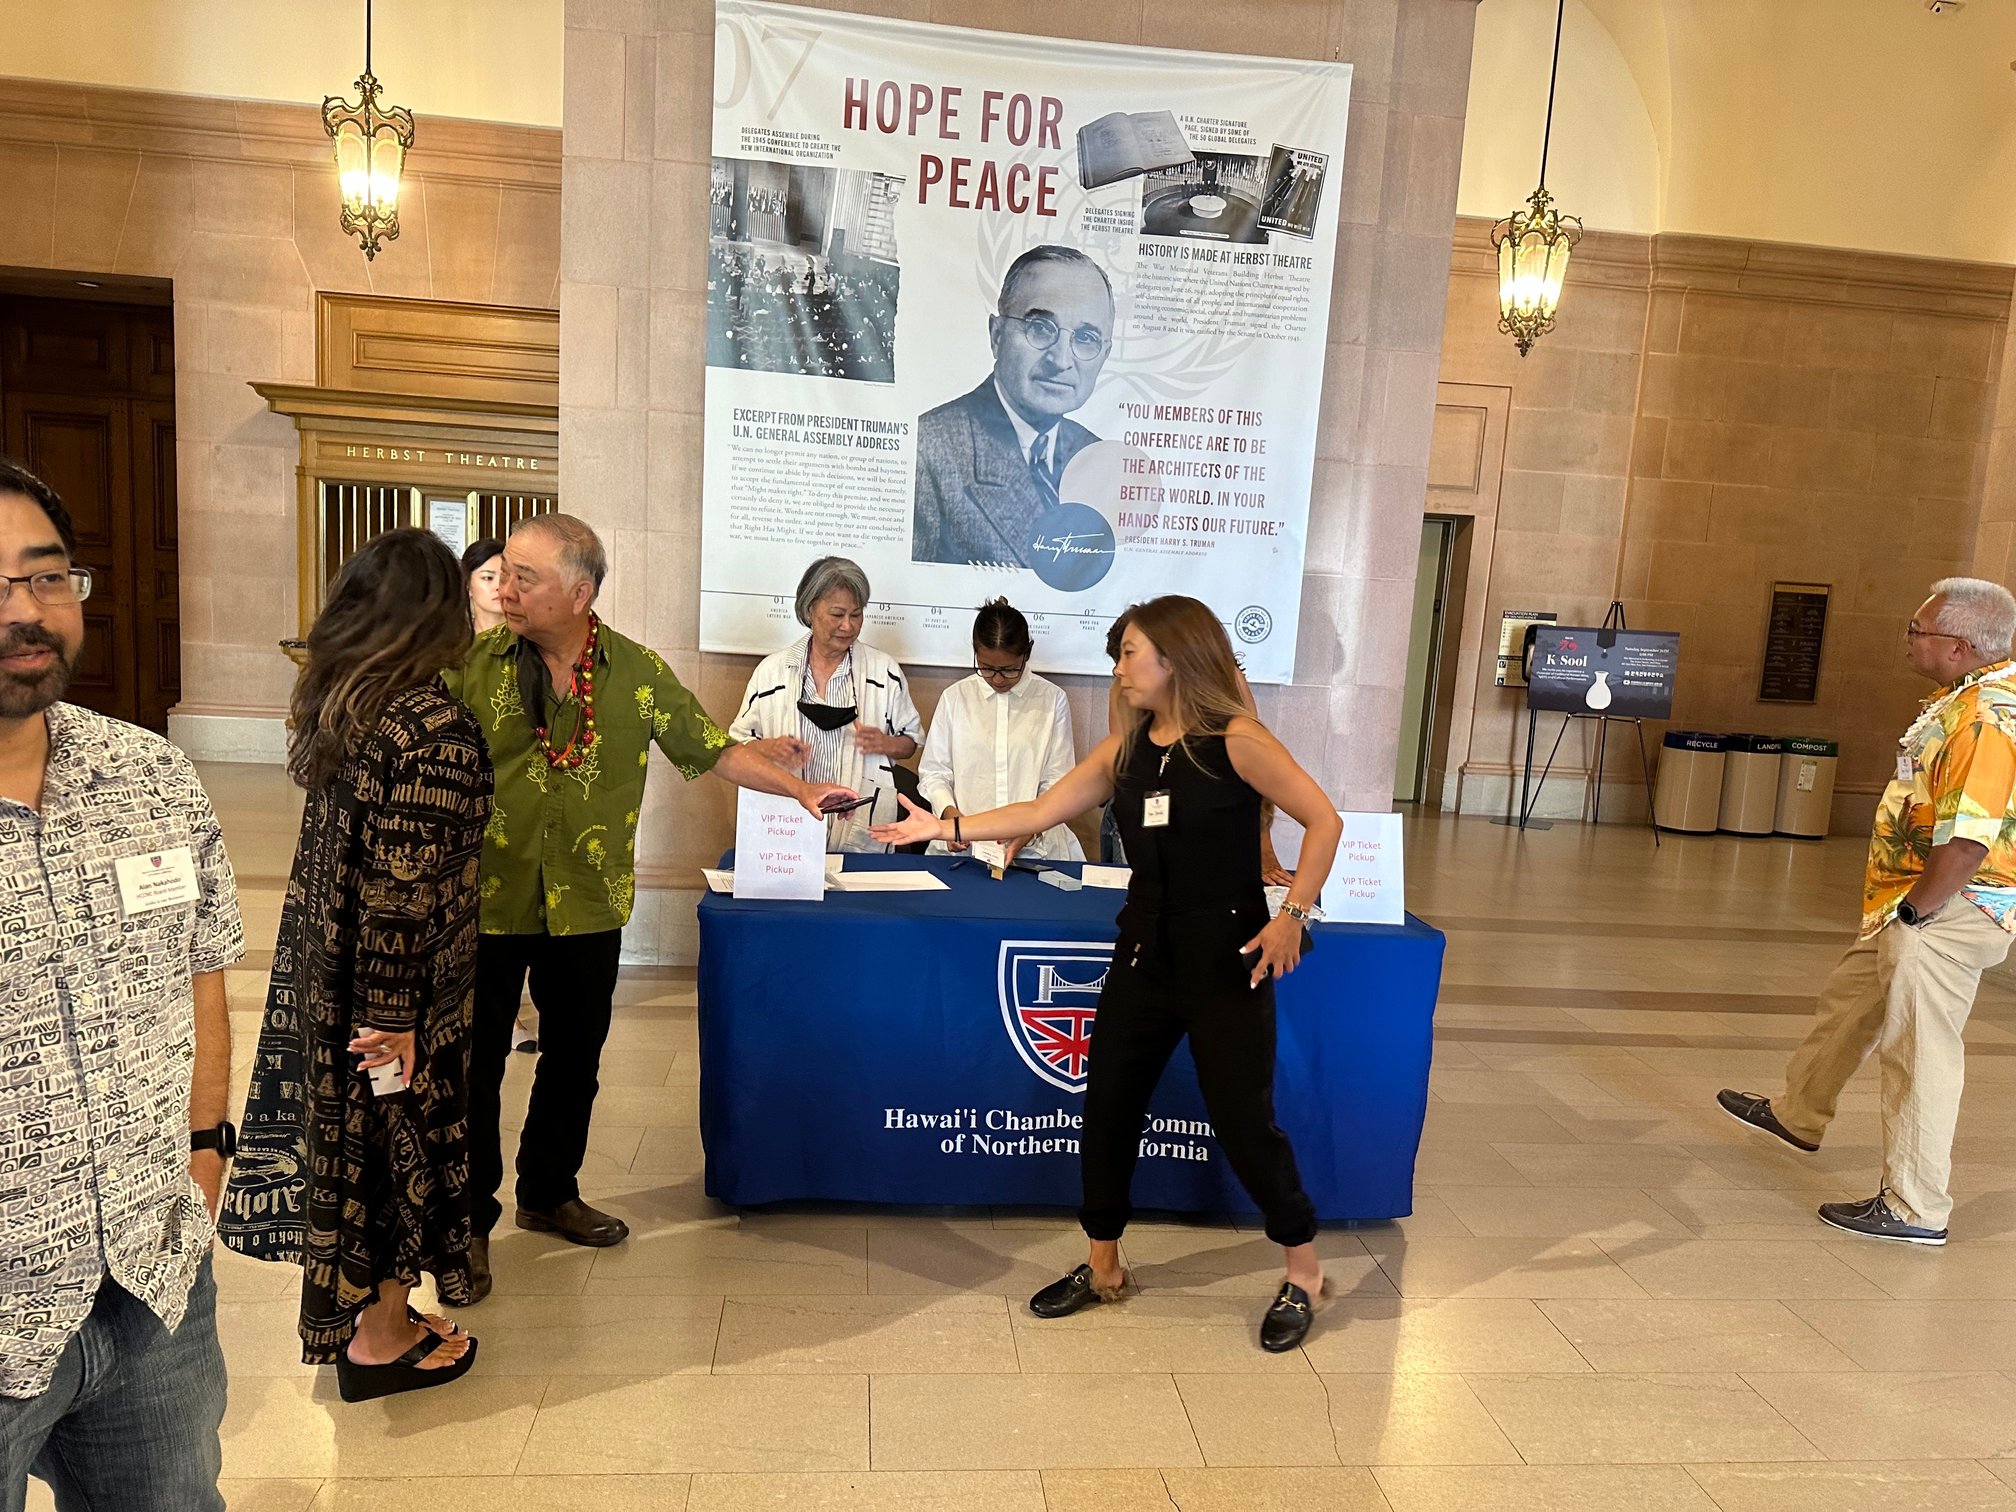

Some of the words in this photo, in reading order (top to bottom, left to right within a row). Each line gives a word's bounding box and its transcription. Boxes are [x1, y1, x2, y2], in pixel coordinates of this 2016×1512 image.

[715, 17, 823, 121] 07
[844, 77, 962, 140] HOPE
[980, 90, 1064, 150] FOR
[1185, 116, 1195, 124] U.N.
[1197, 117, 1220, 126] CHARTER
[1220, 120, 1248, 128] SIGNATURE
[741, 127, 771, 136] DELEGATES
[772, 130, 799, 140] ASSEMBLE
[801, 132, 820, 141] DURING
[767, 138, 801, 148] CONFERENCE
[802, 141, 809, 149] TO
[810, 142, 830, 151] CREATE
[754, 145, 794, 157] INTERNATIONAL
[796, 149, 834, 160] ORGANIZATION
[1298, 153, 1323, 164] UNITED
[918, 154, 1059, 217] PEACE
[1085, 207, 1113, 217] DELEGATES
[1114, 209, 1135, 218] SIGNING
[1094, 216, 1116, 226] CHARTER
[1117, 218, 1134, 227] INSIDE
[1261, 215, 1287, 226] UNITED
[1081, 224, 1091, 232] THE
[1092, 225, 1111, 233] HERBST
[1112, 226, 1134, 235] THEATRE
[1139, 243, 1179, 259] HISTORY
[1180, 246, 1190, 260] IS
[1192, 247, 1218, 262] MADE
[1220, 251, 1231, 264] AT
[1234, 252, 1270, 266] HERBST
[1273, 254, 1312, 270] THEATRE
[1136, 261, 1148, 269] The
[1153, 263, 1165, 271] War
[1170, 264, 1199, 274] Memorial
[1204, 268, 1228, 276] Veterans
[1233, 271, 1259, 279] Building
[1264, 272, 1284, 280] Herbst
[1118, 403, 1150, 420] “YOU
[1154, 405, 1214, 423] MEMBERS
[1218, 409, 1233, 425] OF
[1237, 410, 1263, 427] THIS
[733, 408, 777, 424] EXCERPT
[778, 412, 805, 427] FROM
[807, 415, 859, 431] PRESIDENT
[860, 419, 909, 436] TRUMAN'S
[733, 424, 752, 439] U.N.
[756, 427, 800, 443] GENERAL
[803, 431, 853, 447] ASSEMBLY
[856, 435, 900, 451] ADDRESS
[1124, 430, 1203, 451] CONFERENCE
[1206, 436, 1230, 452] ARE
[1233, 438, 1247, 453] TO
[1250, 439, 1266, 455] BE
[346, 445, 426, 463] HERBST
[444, 452, 540, 471] THEATRE
[1123, 458, 1145, 474] THE
[1148, 460, 1222, 479] ARCHITECTS
[1224, 464, 1240, 480] OF
[1243, 465, 1266, 482] THE
[1120, 485, 1165, 502] BETTER
[1169, 488, 1214, 506] WORLD.
[1217, 491, 1230, 506] IN
[1234, 492, 1265, 509] YOUR
[1118, 512, 1159, 529] HANDS
[1162, 515, 1199, 531] RESTS
[1202, 517, 1226, 534] OUR
[1230, 519, 1285, 537] FUTURE.”
[1160, 537, 1180, 546] HARRY
[1190, 540, 1215, 548] TRUMAN
[774, 596, 785, 604] 01
[879, 603, 891, 612] 03
[931, 607, 942, 616] 04
[1084, 608, 1096, 616] 07
[1033, 613, 1045, 621] 06
[1546, 654, 1556, 665] K
[1560, 655, 1588, 667] Sool
[1686, 740, 1718, 749] RECYCLE
[1792, 743, 1827, 752] COMPOST
[778, 815, 803, 824] Ticket
[767, 827, 796, 837] Pickup
[1342, 841, 1356, 849] VIP
[1357, 841, 1381, 850] Ticket
[759, 853, 774, 861] VIP
[776, 853, 802, 861] Ticket
[1348, 853, 1375, 863] Pickup
[765, 865, 794, 875] Pickup
[1342, 877, 1356, 885] VIP
[1358, 878, 1382, 886] Ticket
[1349, 890, 1376, 899] Pickup
[883, 1108, 978, 1129] Hawai'i
[985, 1109, 1083, 1131] Chambe
[940, 1133, 964, 1154] of
[972, 1134, 1080, 1156] Northern
[1137, 1137, 1209, 1162] fornia
